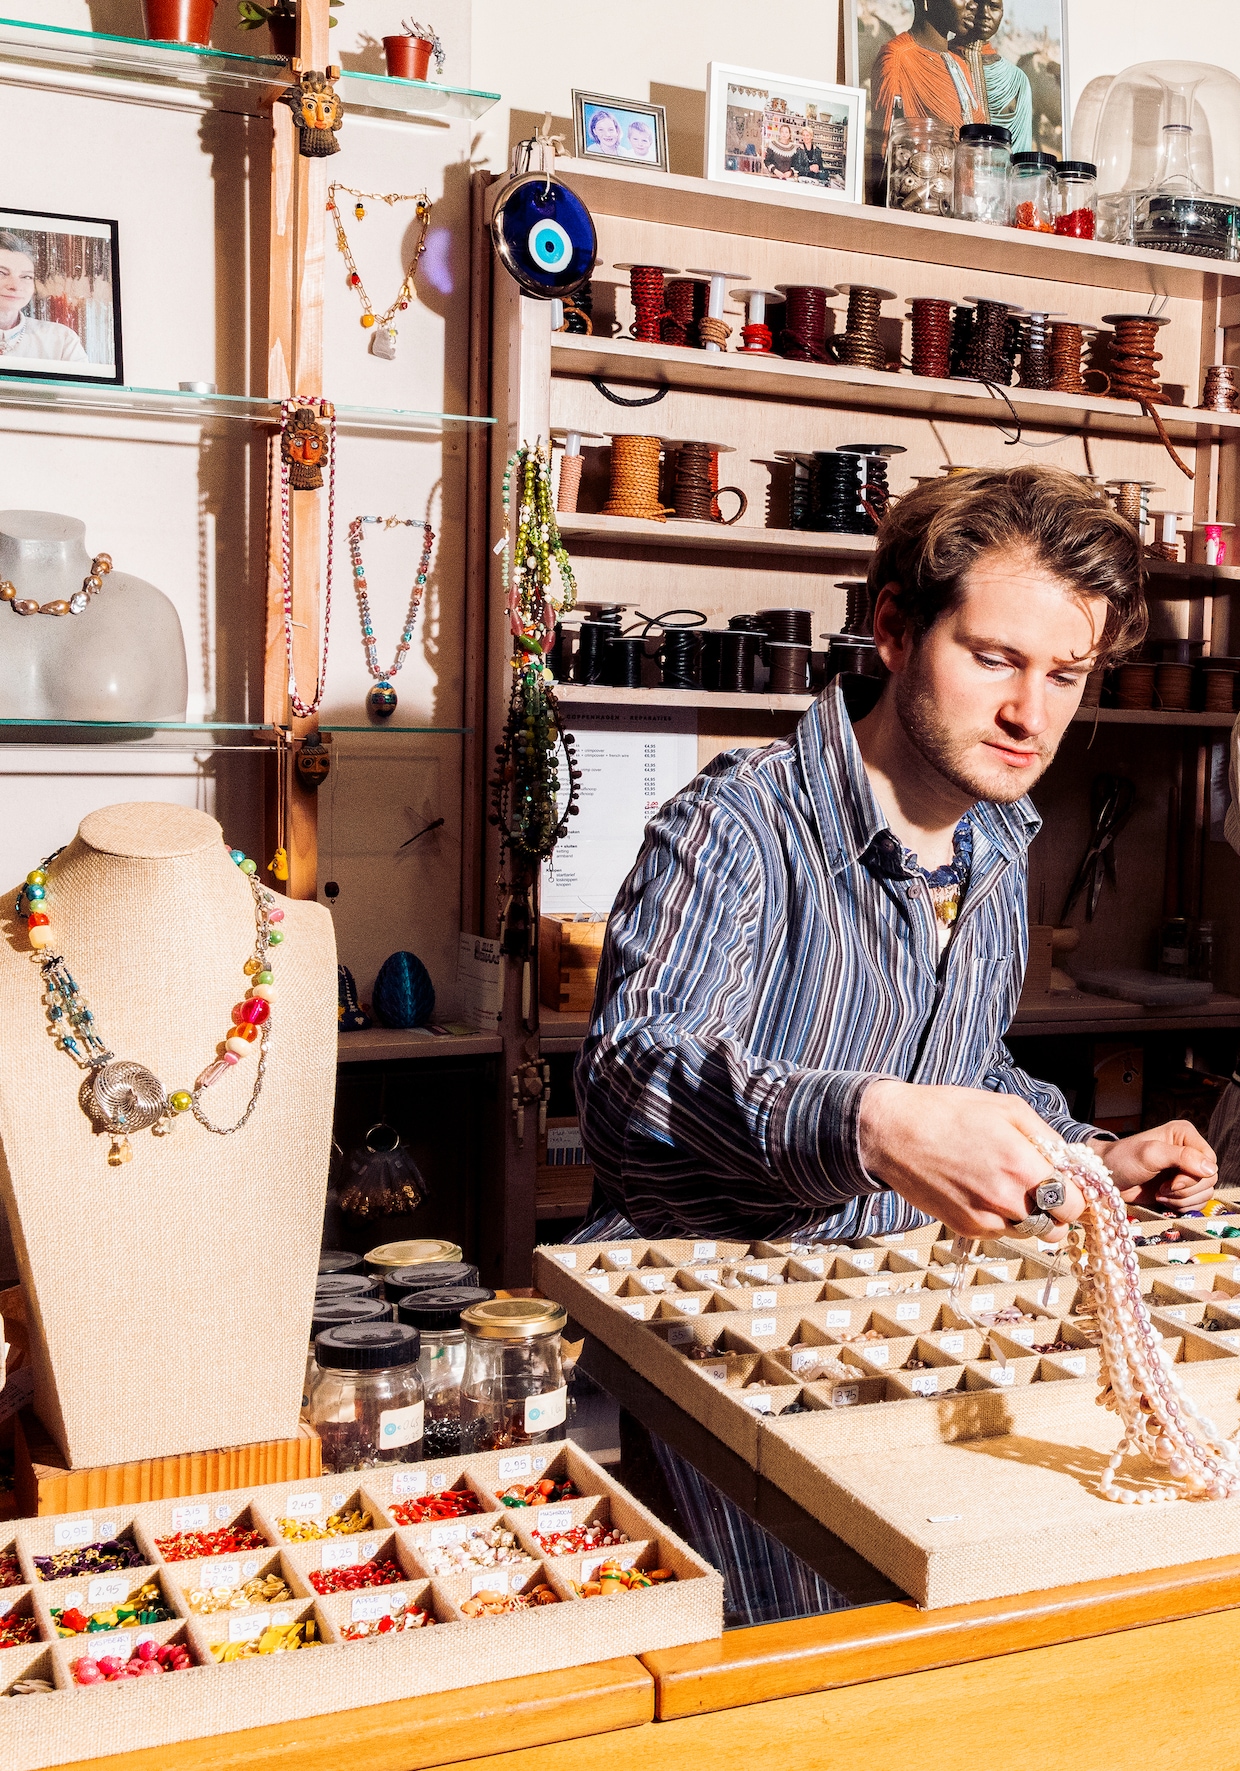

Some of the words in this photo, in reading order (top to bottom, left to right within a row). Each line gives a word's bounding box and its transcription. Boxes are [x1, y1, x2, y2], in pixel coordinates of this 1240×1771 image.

[836, 1390, 857, 1403] 3,75
[504, 1459, 527, 1473] 2,95
[396, 1486, 402, 1494] S
[292, 1499, 317, 1510] 2,45
[61, 1526, 88, 1540] 0,95
[330, 1548, 353, 1560] 3,25
[204, 1579, 211, 1587] S
[95, 1583, 121, 1597] 2,95
[352, 1606, 383, 1618] €3,45
[234, 1620, 261, 1634] 3,25
[89, 1634, 130, 1647] RASPBERRY
